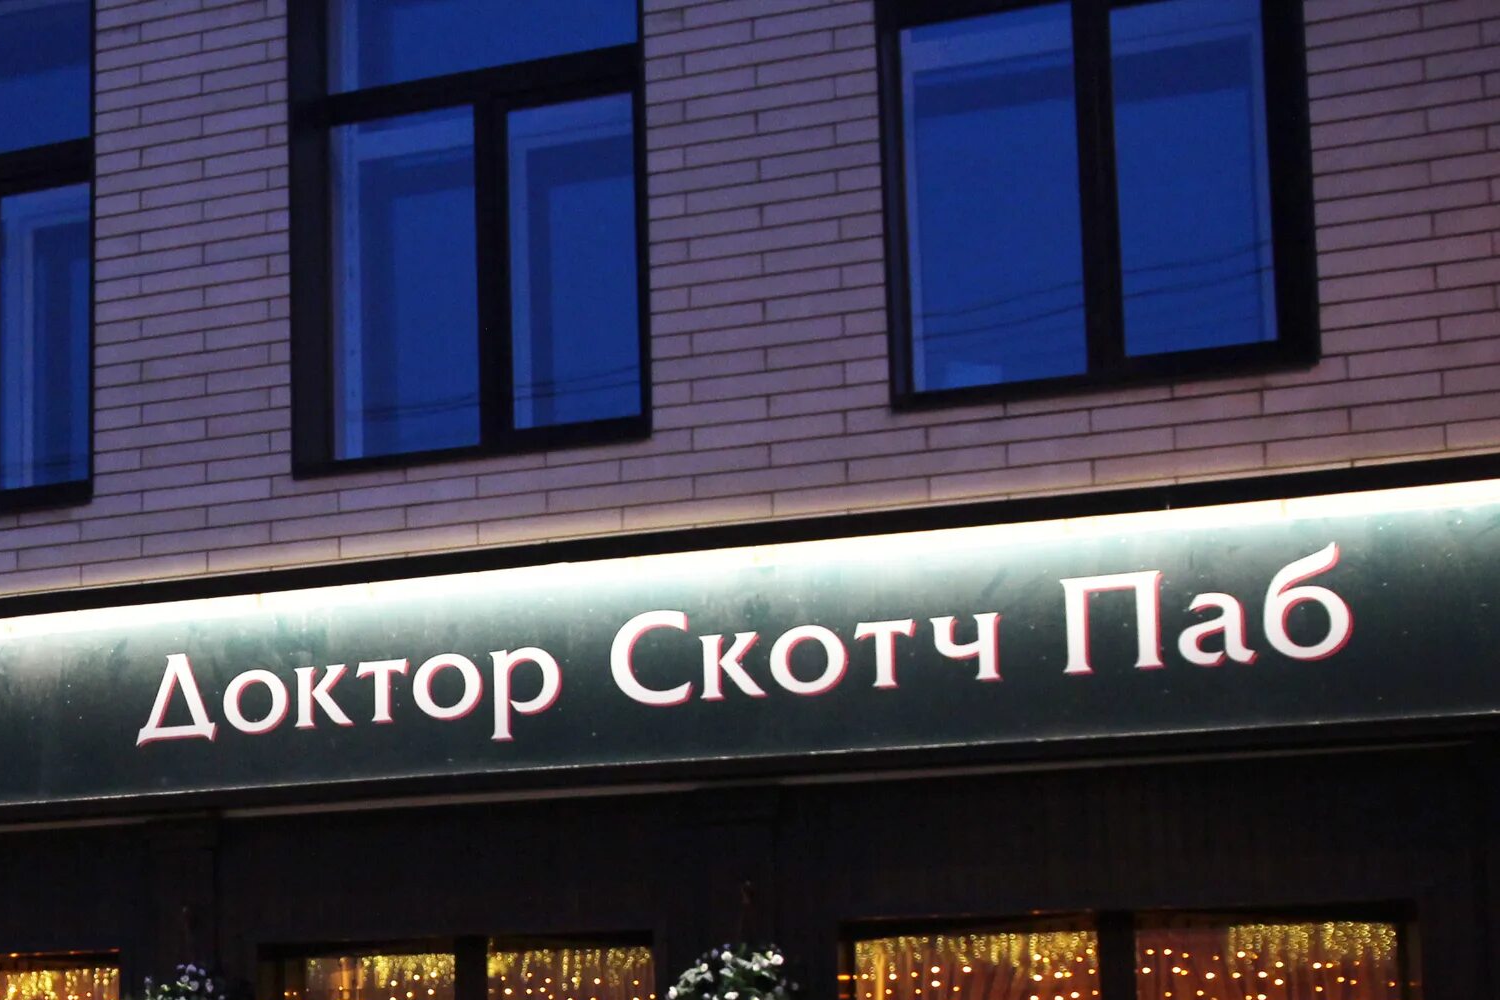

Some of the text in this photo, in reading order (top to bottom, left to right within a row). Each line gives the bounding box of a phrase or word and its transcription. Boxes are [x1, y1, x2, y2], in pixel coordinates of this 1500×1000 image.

[136, 542, 1352, 747] Доктор Скотч Паб
